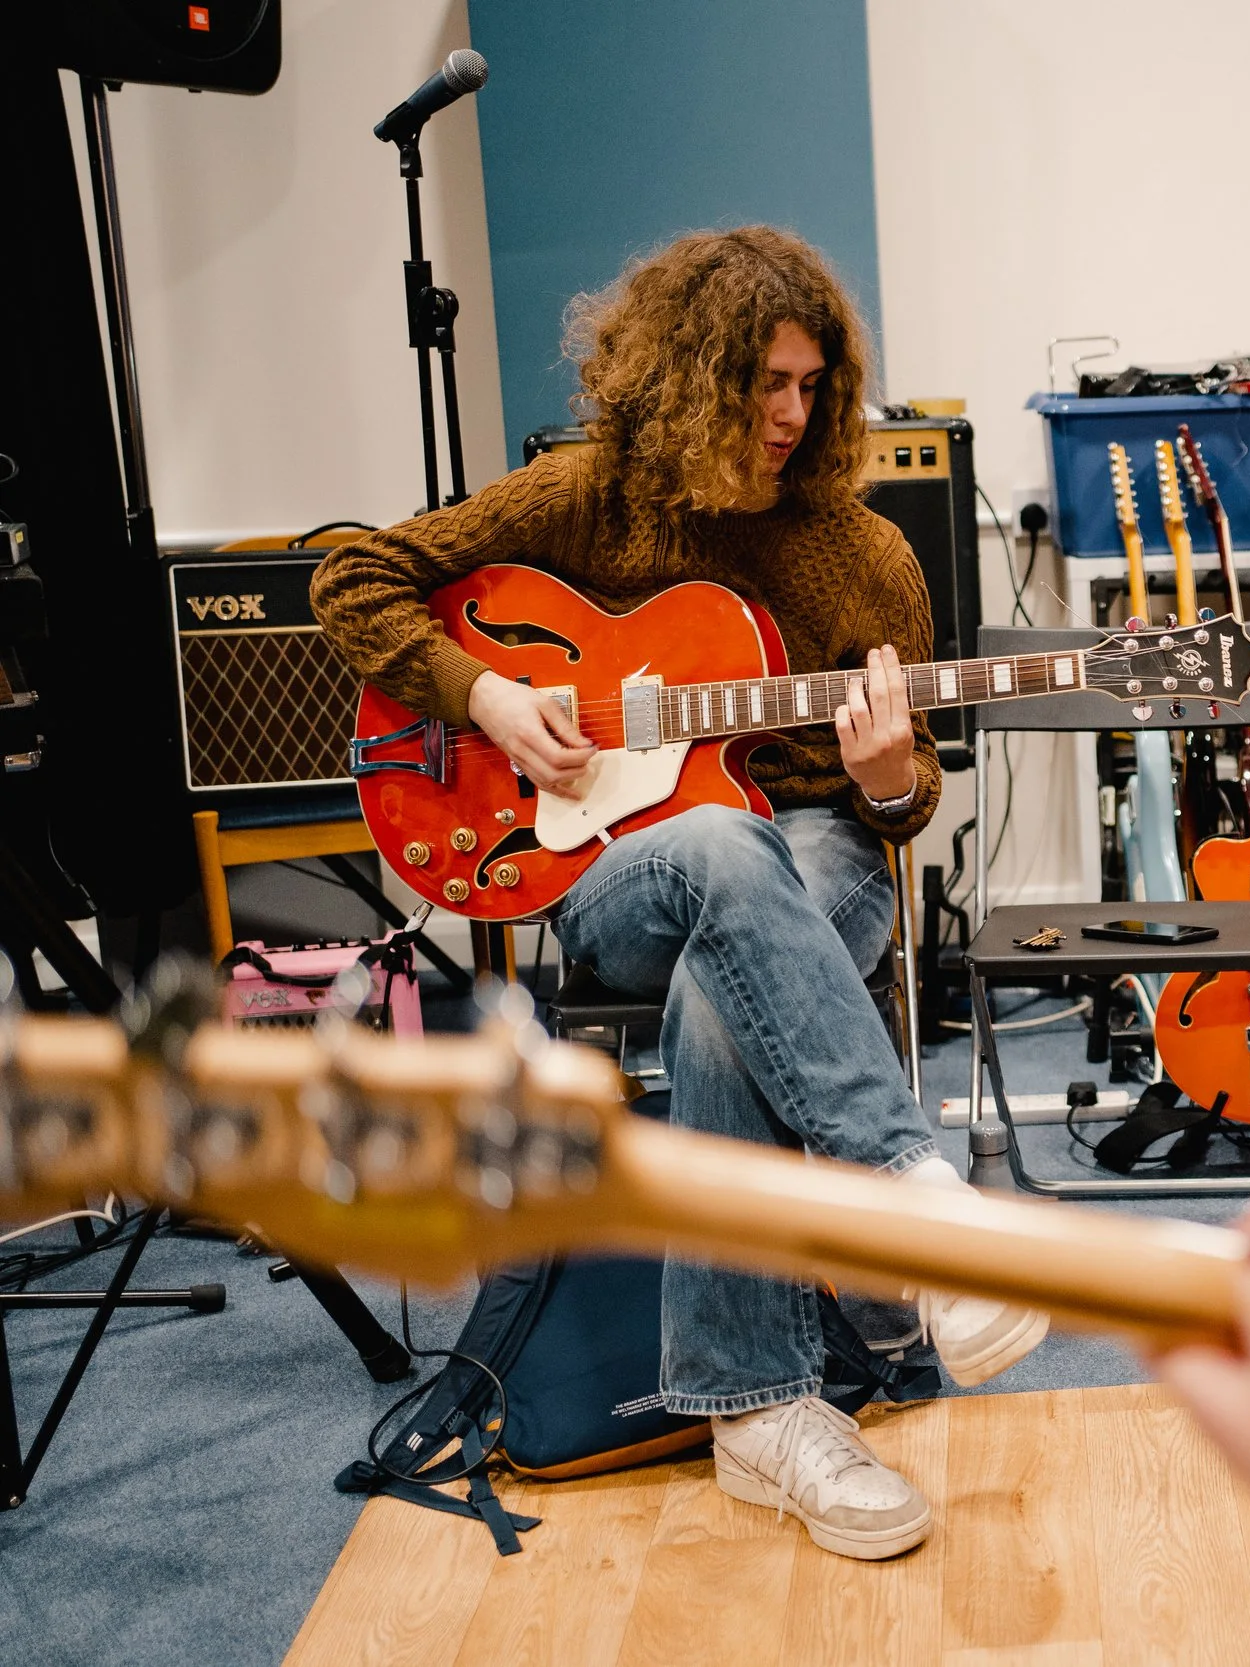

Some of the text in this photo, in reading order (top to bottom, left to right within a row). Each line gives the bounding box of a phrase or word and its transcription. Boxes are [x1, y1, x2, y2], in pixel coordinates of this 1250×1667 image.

[186, 594, 266, 621] VOX
[1219, 632, 1234, 688] Ibanez
[238, 989, 293, 1008] VOX
